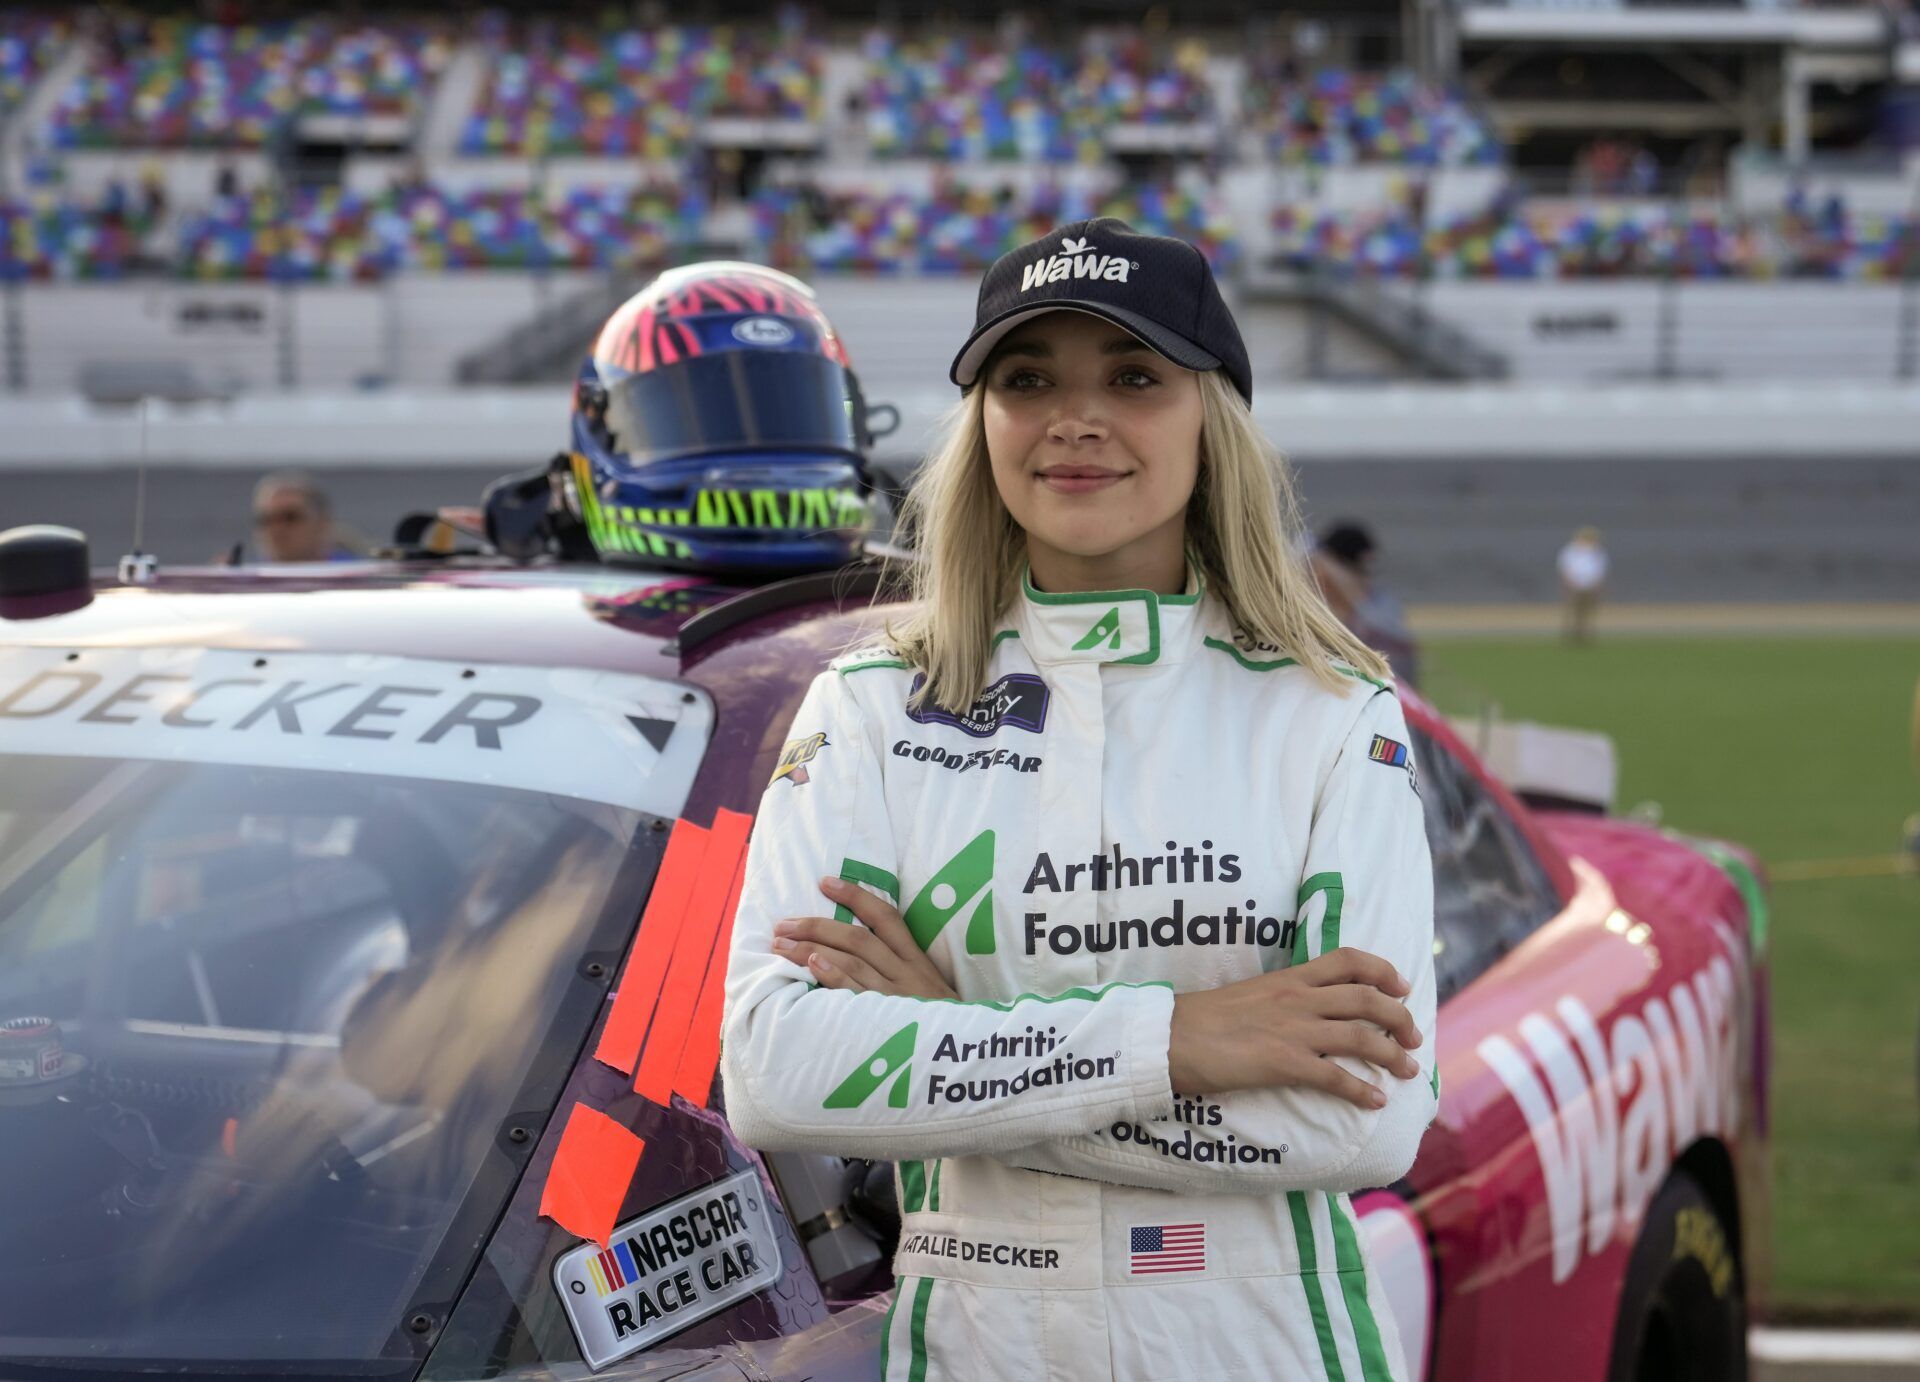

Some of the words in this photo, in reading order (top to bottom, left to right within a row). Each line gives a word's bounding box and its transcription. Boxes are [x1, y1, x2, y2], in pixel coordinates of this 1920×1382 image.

[0, 669, 543, 750] DECKER
[976, 681, 1008, 702] ASCAR
[960, 717, 997, 732] SERIES
[892, 740, 1043, 774] GOODYEAR
[1022, 840, 1242, 894] Arthritis
[1024, 899, 1298, 956] Foundation
[931, 1025, 1069, 1063] Arthriti
[927, 1052, 1116, 1105] Foundation
[1095, 1121, 1283, 1165] oundation
[626, 1191, 749, 1278] NASCAR
[961, 1241, 1059, 1269] DECKER
[607, 1270, 698, 1338] RACE
[701, 1242, 760, 1291] CAR
